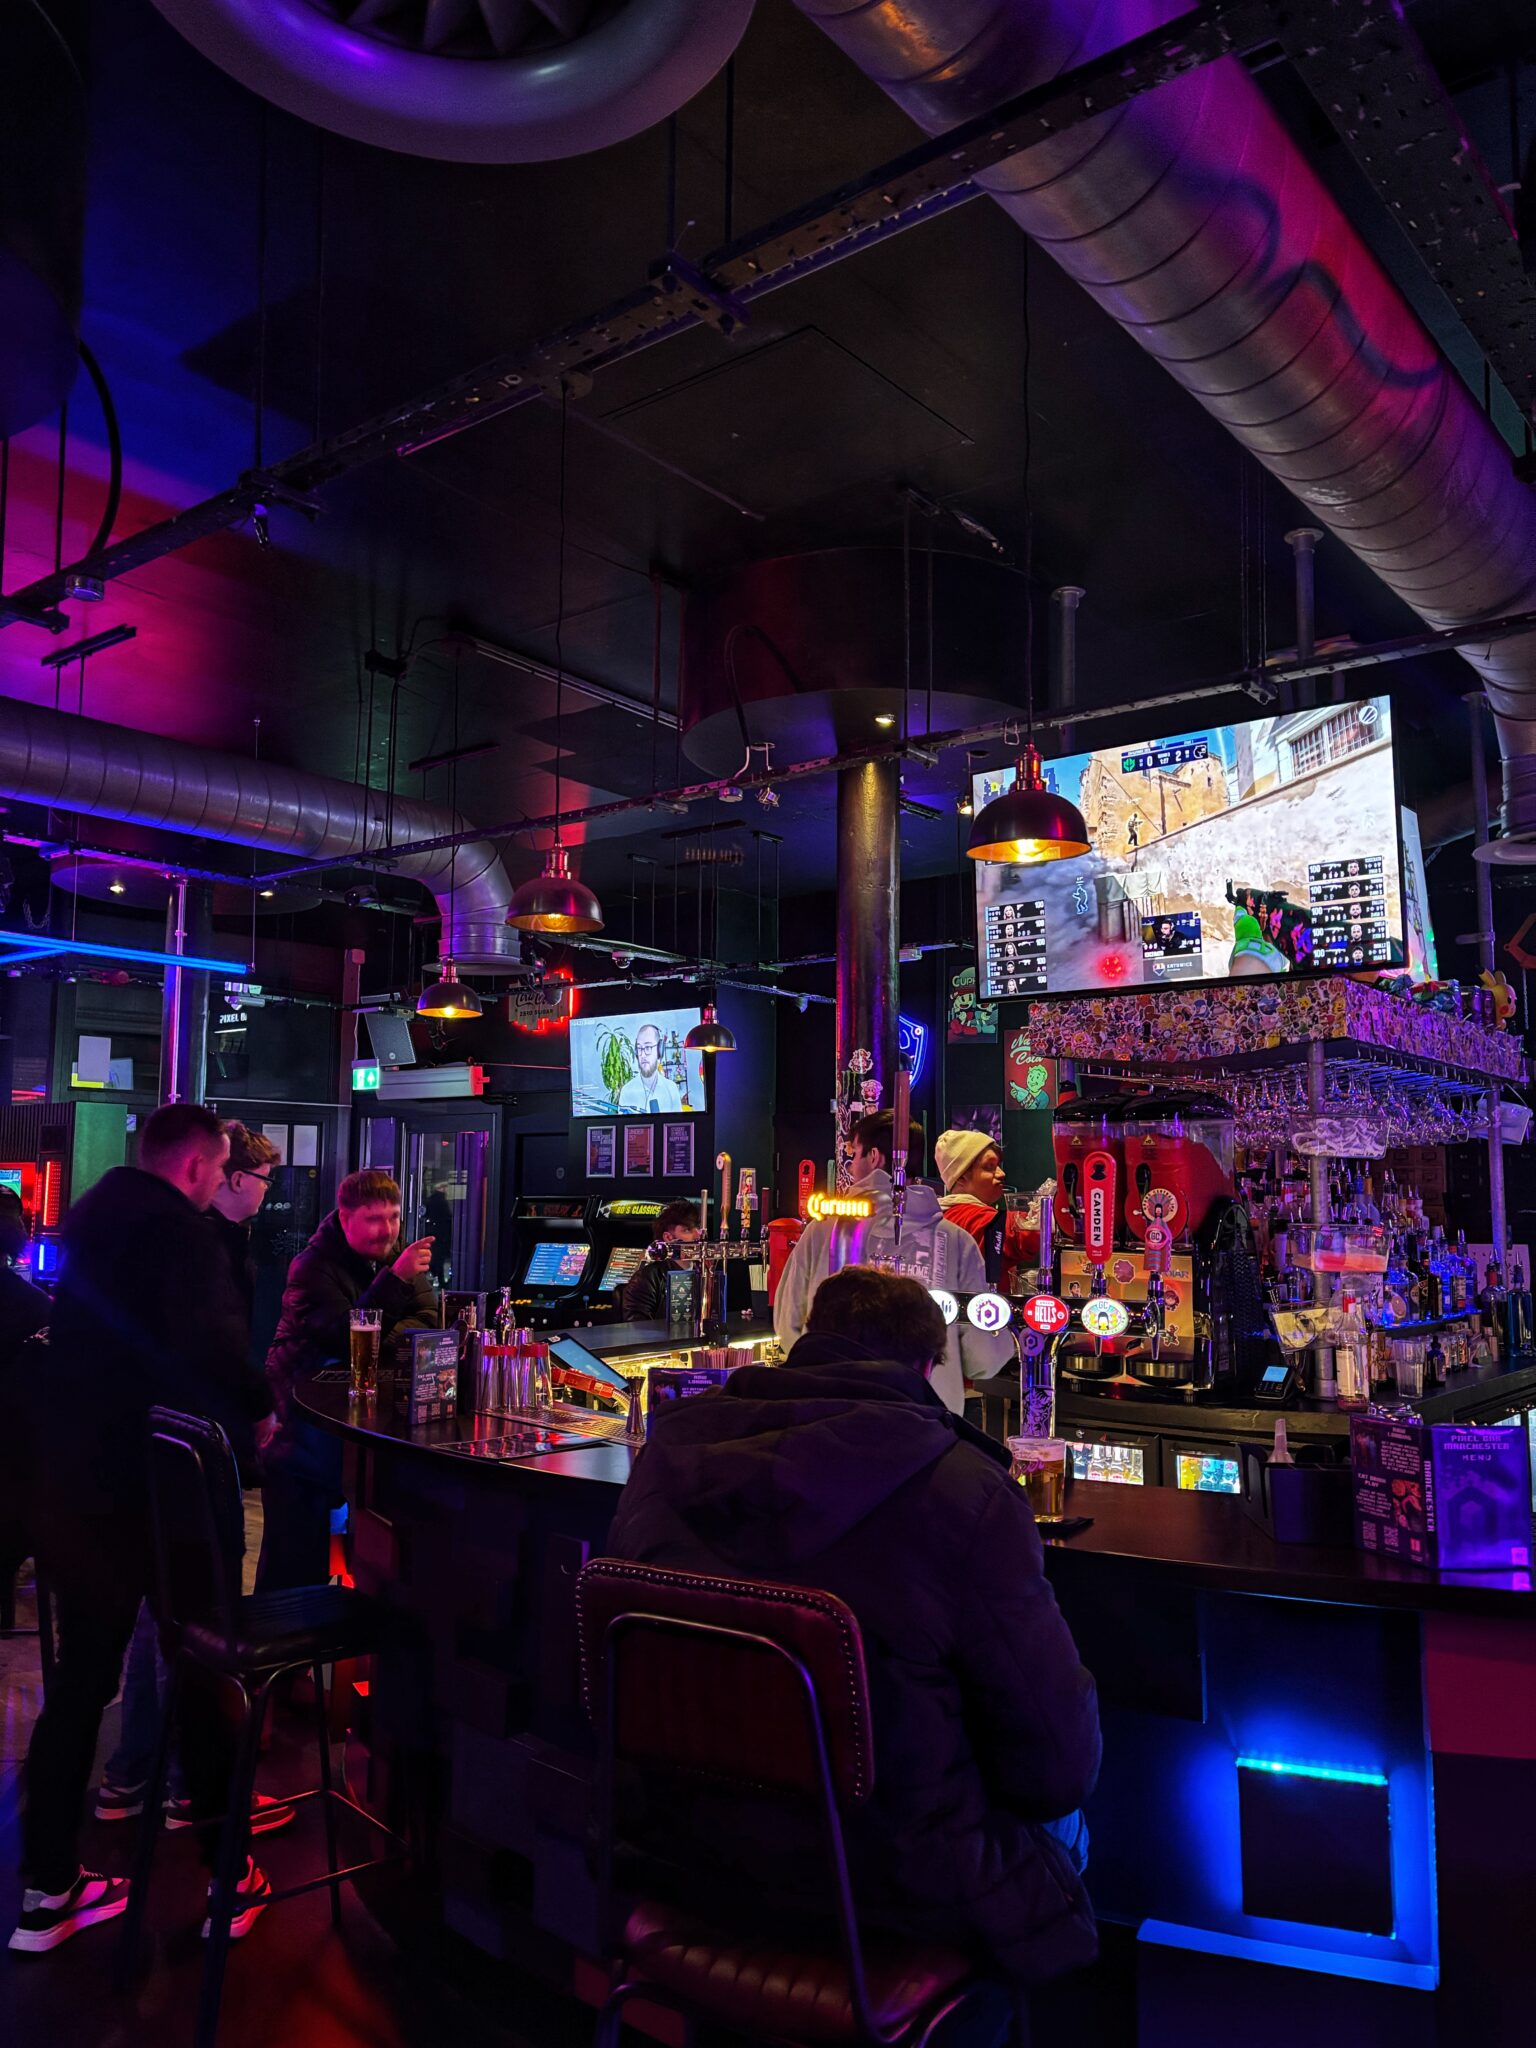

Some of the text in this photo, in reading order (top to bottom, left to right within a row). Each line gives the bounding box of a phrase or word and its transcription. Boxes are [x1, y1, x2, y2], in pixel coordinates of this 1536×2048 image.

[1175, 750, 1182, 762] 2
[1309, 864, 1321, 874] 100
[1310, 885, 1322, 895] 100
[1311, 906, 1323, 916] 100
[1312, 927, 1324, 937] 100
[1313, 948, 1325, 958] 100
[631, 1203, 661, 1216] CLASSICS
[807, 1192, 870, 1221] Corona
[1092, 1191, 1102, 1242] CAMDEN
[1098, 1300, 1109, 1310] GC
[1034, 1305, 1057, 1324] HELLS
[1482, 1434, 1502, 1442] BAR
[1443, 1442, 1510, 1450] MANCHESTER
[1424, 1460, 1435, 1532] MANCHESTER
